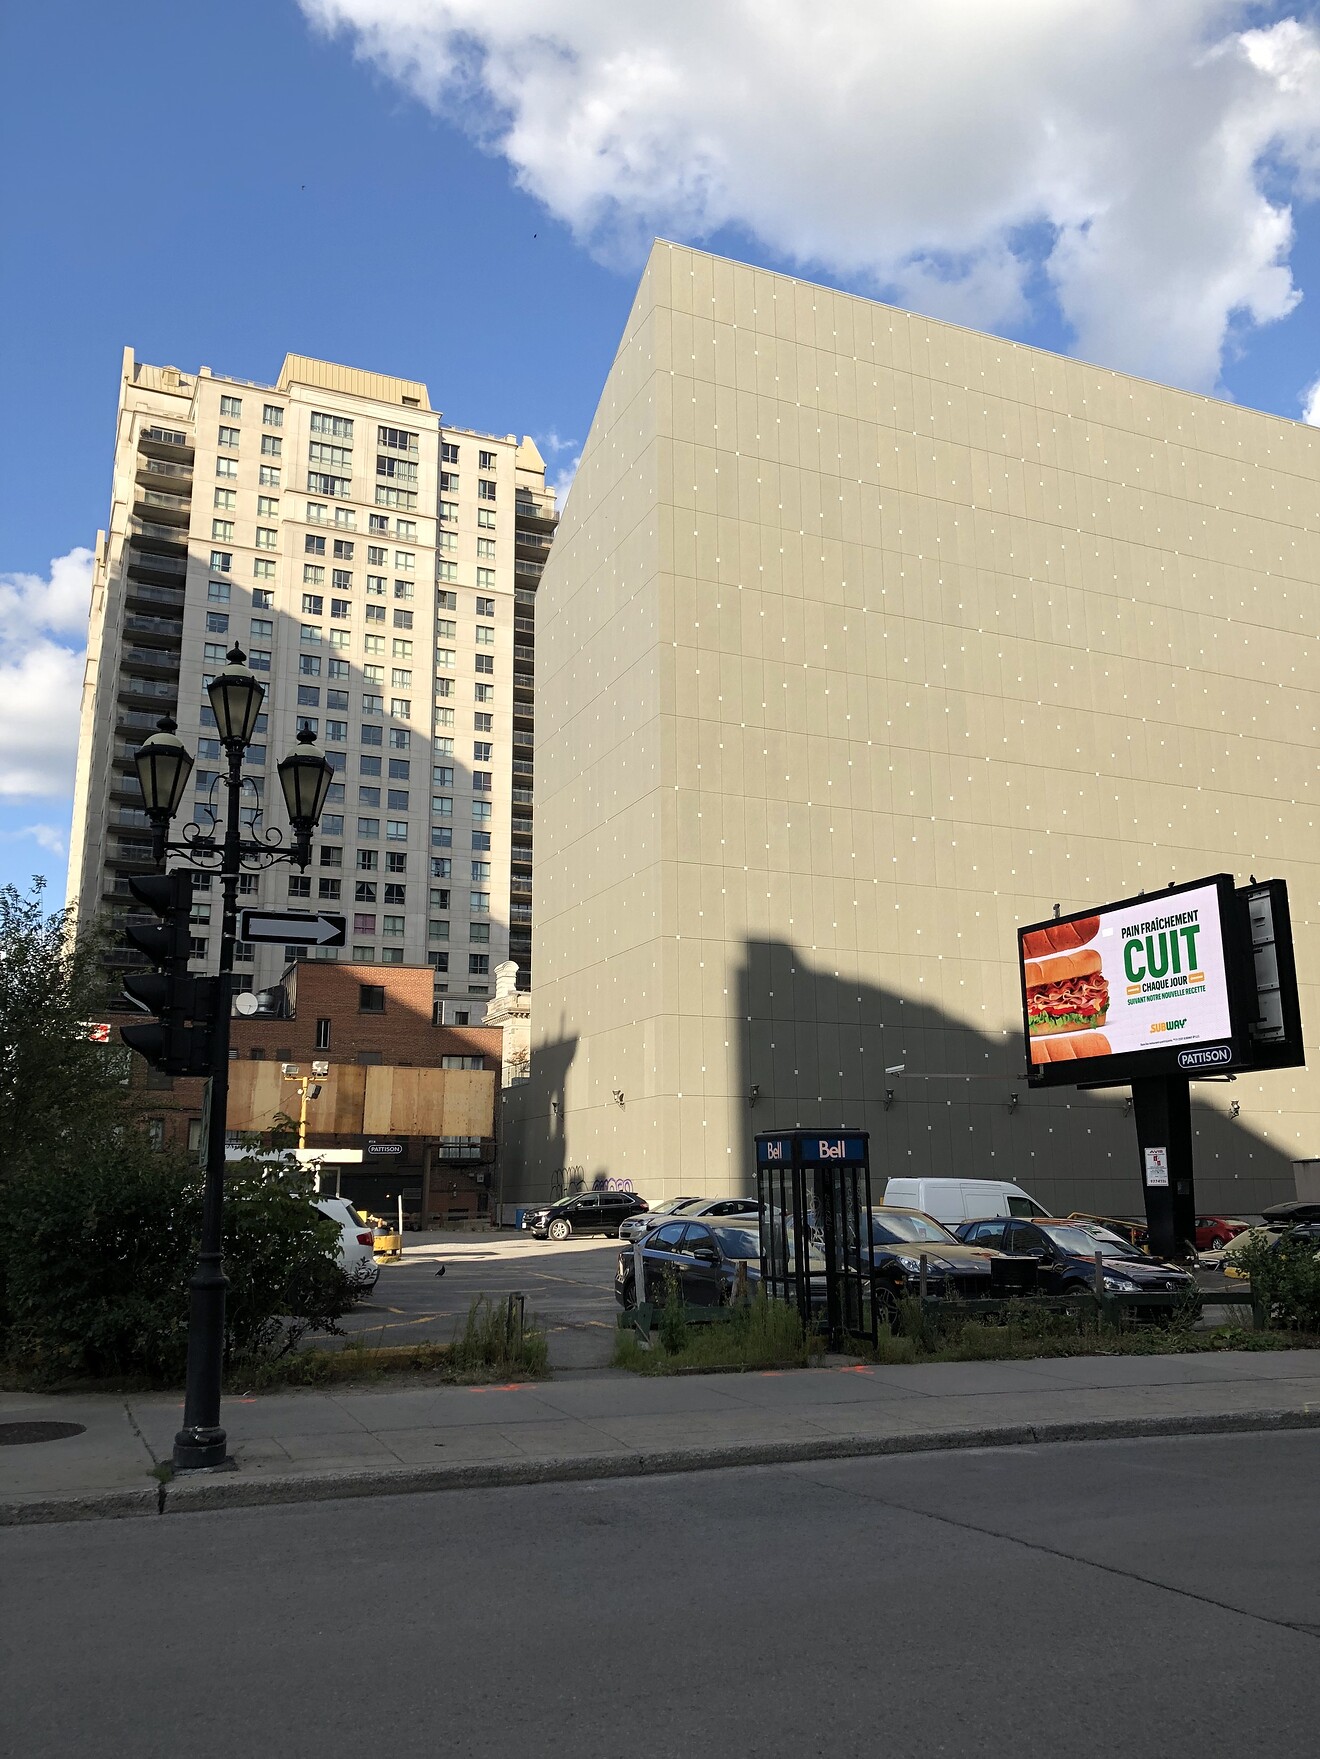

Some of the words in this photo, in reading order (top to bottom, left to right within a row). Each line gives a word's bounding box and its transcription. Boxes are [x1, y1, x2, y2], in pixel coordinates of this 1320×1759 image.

[1121, 924, 1140, 939] PAIN
[1140, 909, 1199, 935] FRAÎCHEMENT
[1123, 924, 1200, 983] CUIT
[1142, 978, 1169, 992] CHAQUE
[1170, 975, 1188, 988] JOUR
[1127, 996, 1146, 1005] SUIVANT
[1146, 993, 1161, 1002] NOTRE
[1161, 988, 1185, 1000] NOUVELLE
[1185, 985, 1206, 995] RECETTE
[1150, 1018, 1187, 1034] SUBWAY
[1181, 1049, 1228, 1065] PATTISON
[767, 1141, 782, 1160] Bell
[819, 1140, 846, 1159] Bell
